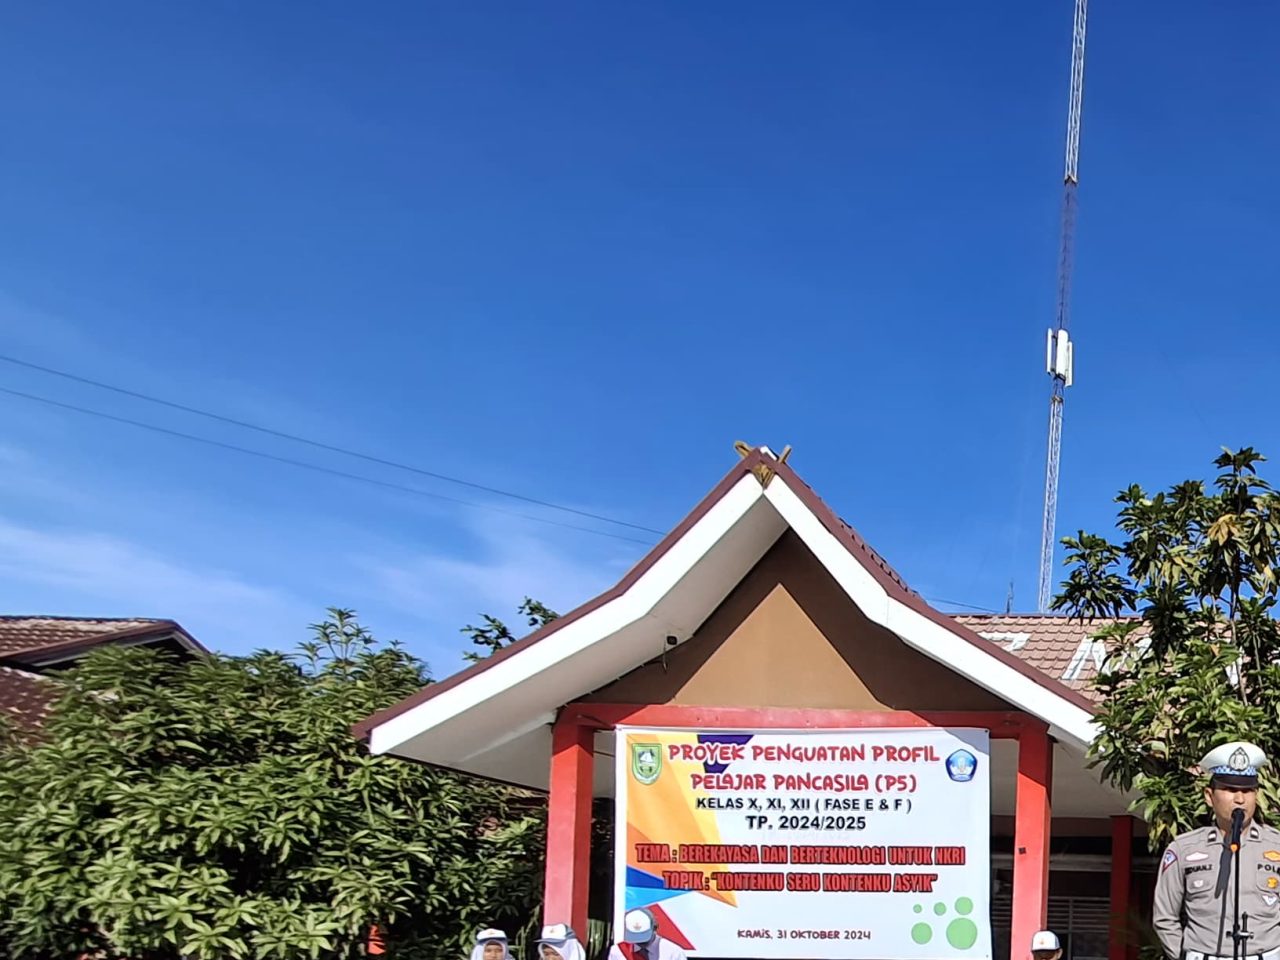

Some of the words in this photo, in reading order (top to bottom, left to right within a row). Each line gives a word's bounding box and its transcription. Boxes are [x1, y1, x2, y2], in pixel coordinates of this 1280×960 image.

[668, 744, 744, 761] PROYEK
[752, 743, 865, 762] PENGUATAN
[872, 745, 940, 762] PROFIL
[691, 773, 766, 790] PELAJAR
[773, 772, 868, 792] PANCASILA
[875, 774, 916, 793] (P5)
[696, 798, 743, 809] KELAS
[748, 798, 762, 812] X,
[766, 798, 786, 812] XI,
[791, 799, 810, 809] XII
[825, 799, 860, 810] FASE
[864, 800, 873, 810] E
[879, 800, 889, 810] &
[894, 800, 902, 810] F
[746, 816, 772, 829] TP.
[778, 816, 866, 830] 2024/2025
[635, 843, 670, 862] TEMA
[679, 844, 759, 864] BEREKAYASA
[761, 845, 788, 864] DAN
[790, 845, 886, 864] BERTEKNOLOGI
[888, 846, 932, 865] UNTUK
[934, 846, 966, 866] NKRI
[662, 871, 704, 890] TOPIK
[786, 872, 820, 892] SERU
[822, 873, 891, 892] KONTENKU
[776, 930, 787, 939] 31
[790, 930, 840, 940] OKTOBER
[844, 930, 871, 940] 2024
